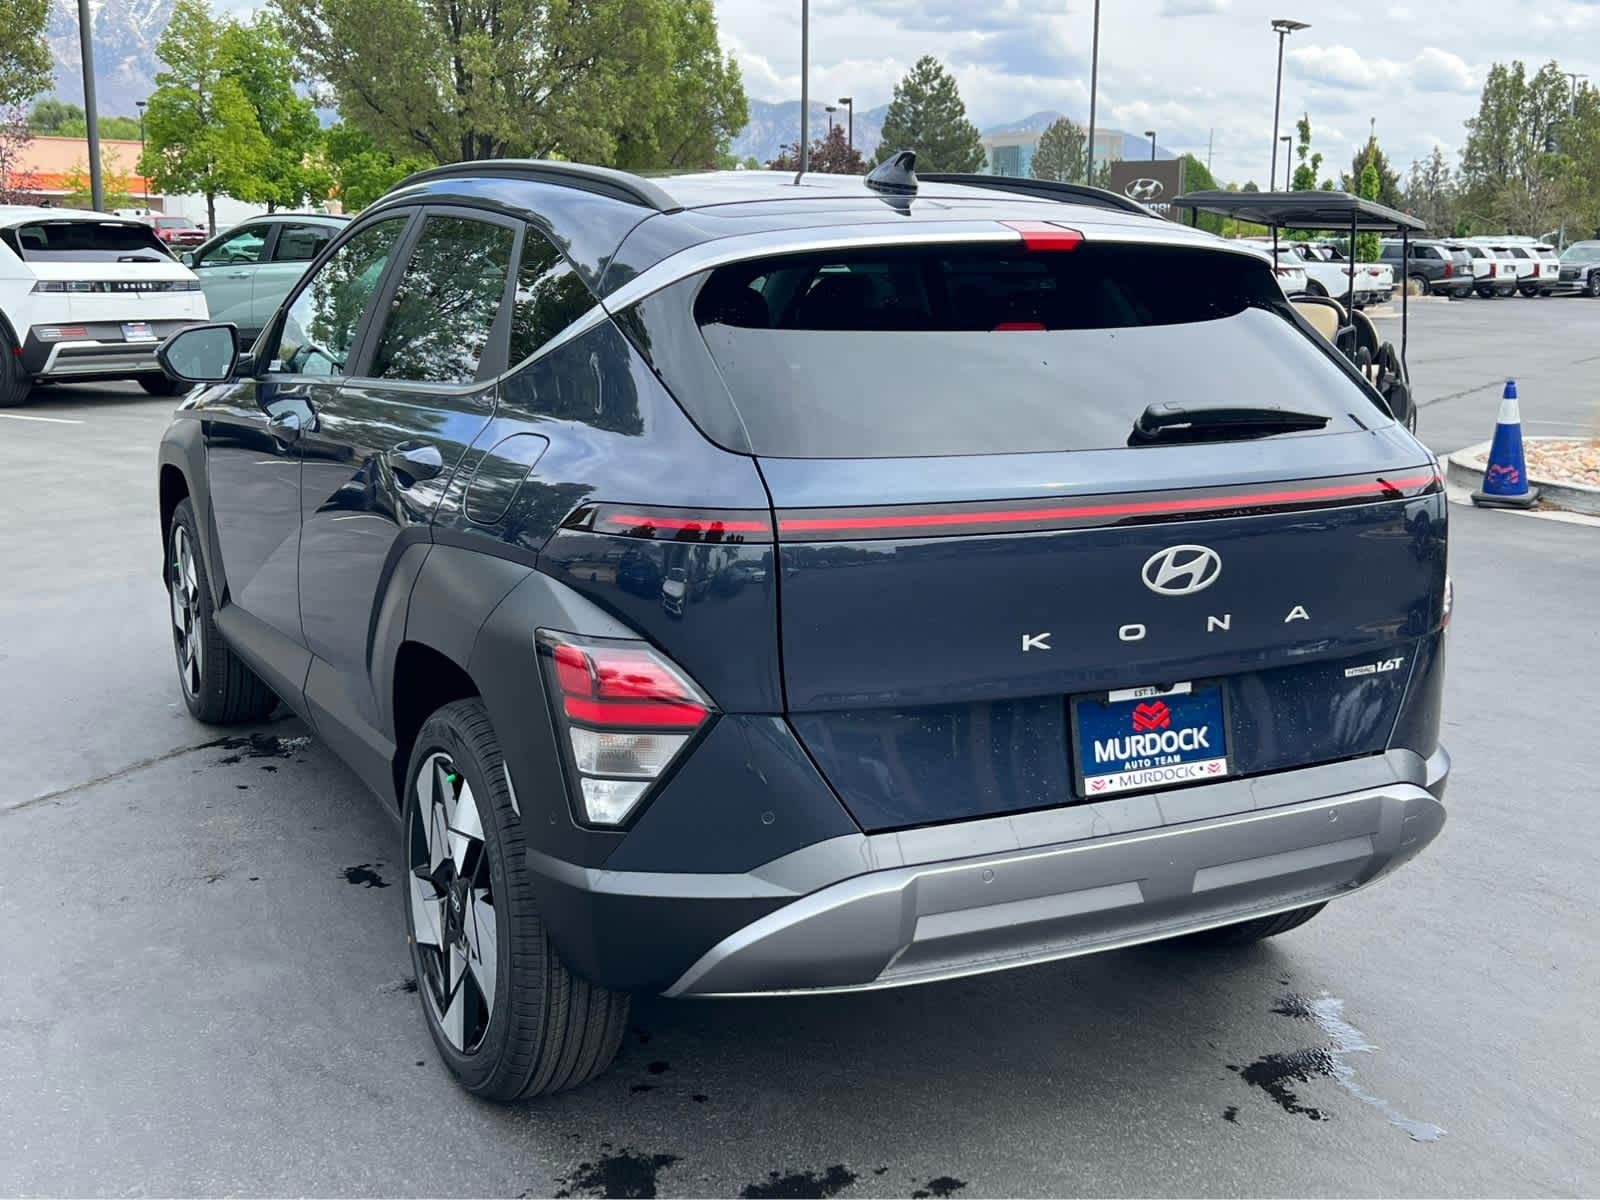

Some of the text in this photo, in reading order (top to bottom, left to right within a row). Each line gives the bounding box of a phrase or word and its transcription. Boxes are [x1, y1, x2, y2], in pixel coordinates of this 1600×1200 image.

[1022, 605, 1310, 651] KONA
[1094, 726, 1209, 763] MURDOCK
[1119, 765, 1195, 787] MURDOCK
[1124, 754, 1181, 770] AUTO TEAM
